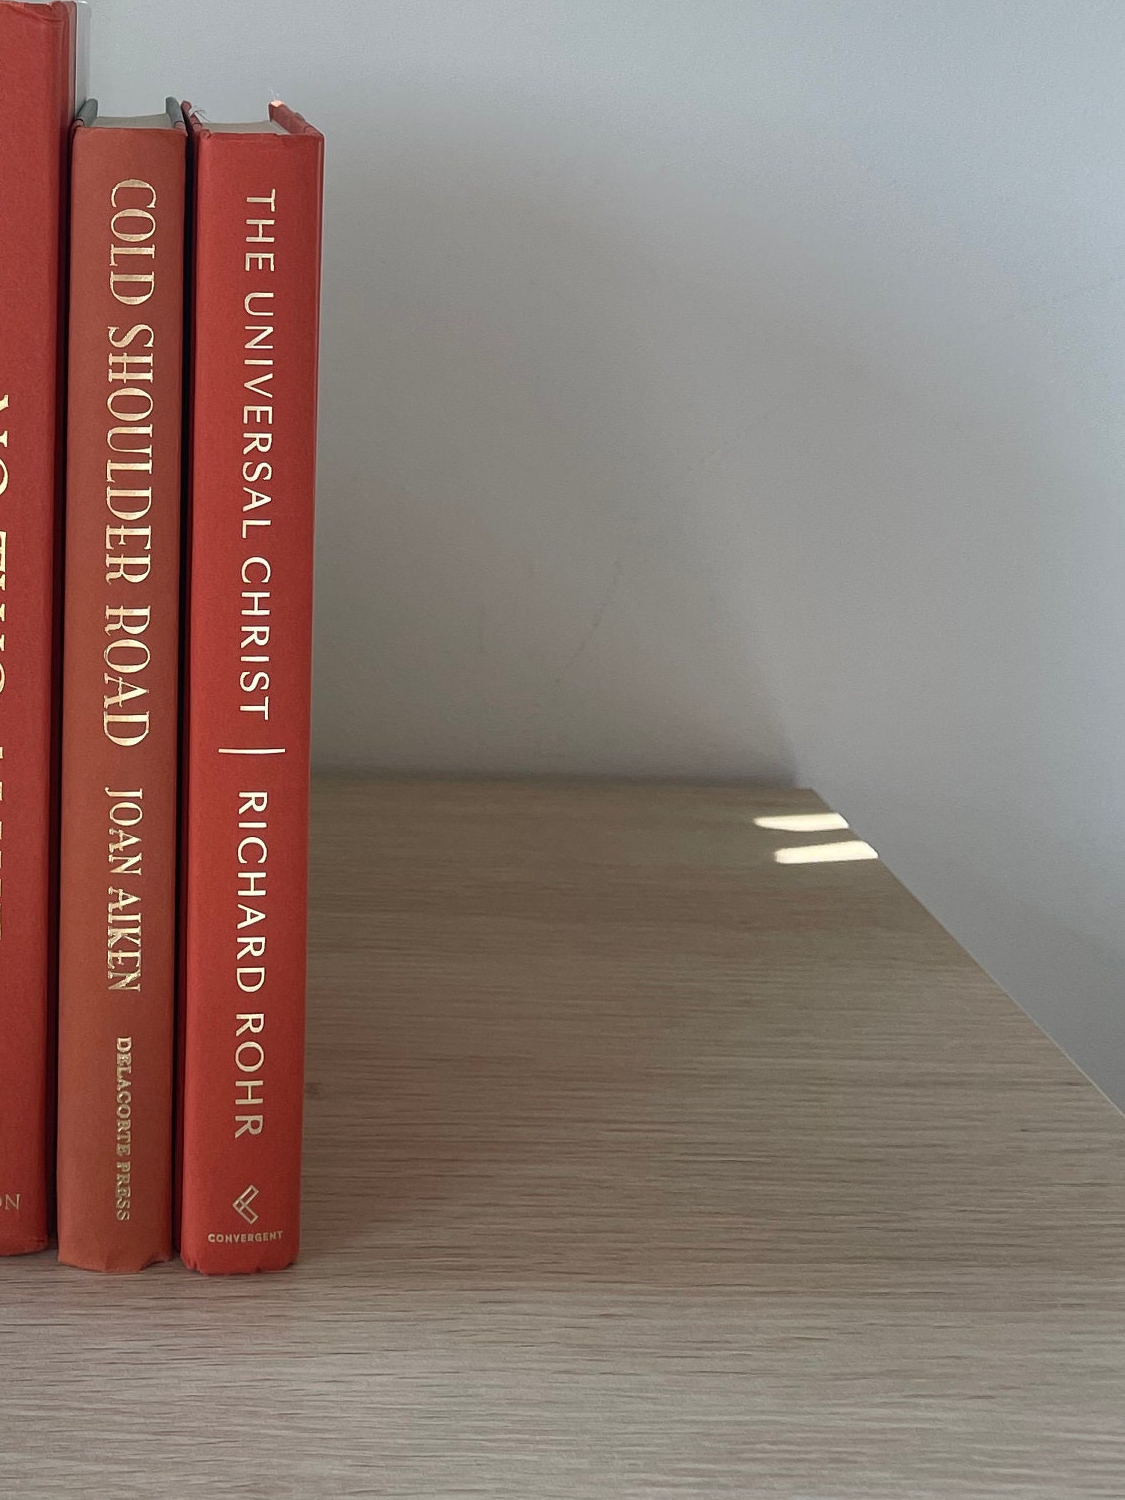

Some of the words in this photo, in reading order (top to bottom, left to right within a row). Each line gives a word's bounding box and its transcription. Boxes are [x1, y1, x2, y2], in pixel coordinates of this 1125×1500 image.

[108, 178, 157, 306] COLD
[244, 187, 276, 272] THE
[105, 323, 155, 586] SHOULDER
[241, 291, 275, 539] UNIVERSAL
[102, 604, 152, 747] ROAD
[239, 556, 272, 721] CHRIST
[104, 786, 144, 877] JOAN
[236, 791, 268, 993] RICHARD
[107, 885, 142, 993] AIKEN
[115, 1036, 133, 1157] DELACORTE
[234, 1013, 265, 1139] ROHR
[114, 1160, 132, 1221] PRESS
[207, 1230, 284, 1245] CONVERGENT
